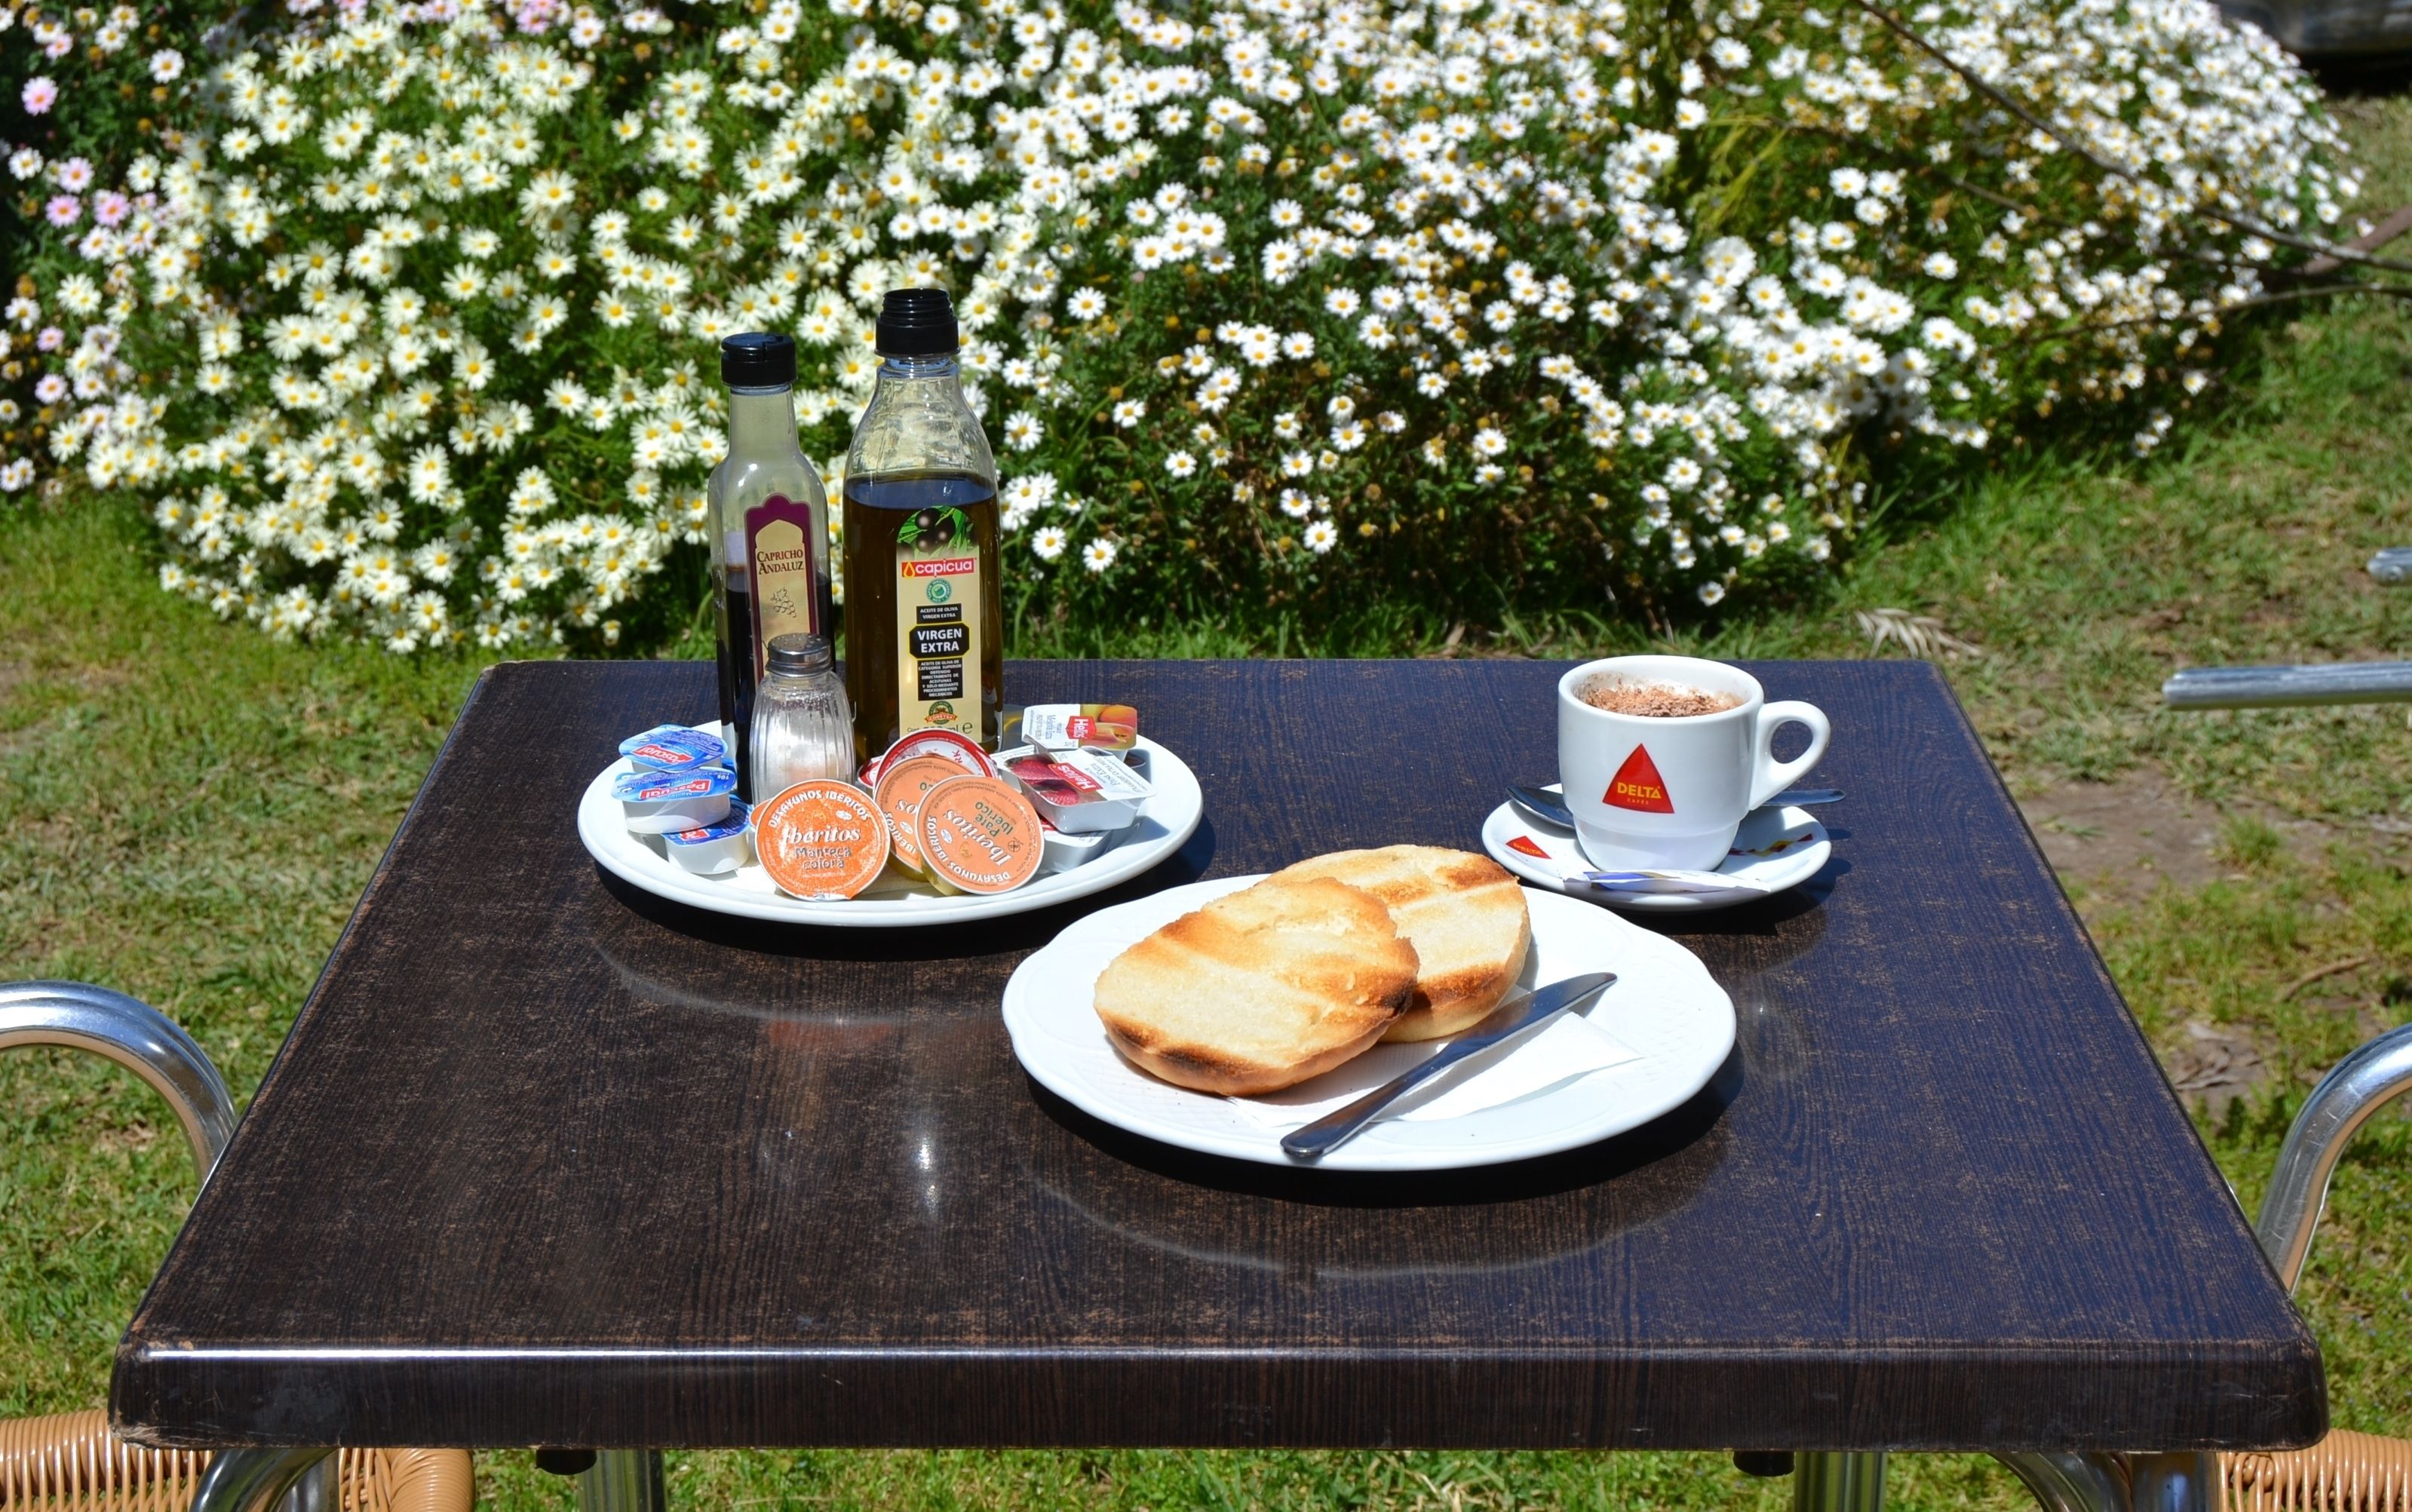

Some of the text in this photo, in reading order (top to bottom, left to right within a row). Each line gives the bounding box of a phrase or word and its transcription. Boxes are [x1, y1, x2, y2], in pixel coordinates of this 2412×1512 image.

[756, 549, 803, 563] CAPRICHO
[759, 560, 805, 575] ANDALUZ
[915, 560, 972, 575] capicua
[917, 628, 962, 641] VIRGEN
[920, 641, 959, 653] EXTRA
[1073, 718, 1089, 739] Helios
[1057, 765, 1097, 790] Helios
[646, 781, 707, 799] Pascual
[1616, 781, 1662, 799] DELTA
[768, 790, 823, 828] DESAYUNOS
[944, 808, 1012, 866] Iberitos
[796, 846, 852, 859] Manteca
[949, 860, 1011, 882] DESAYUNOS
